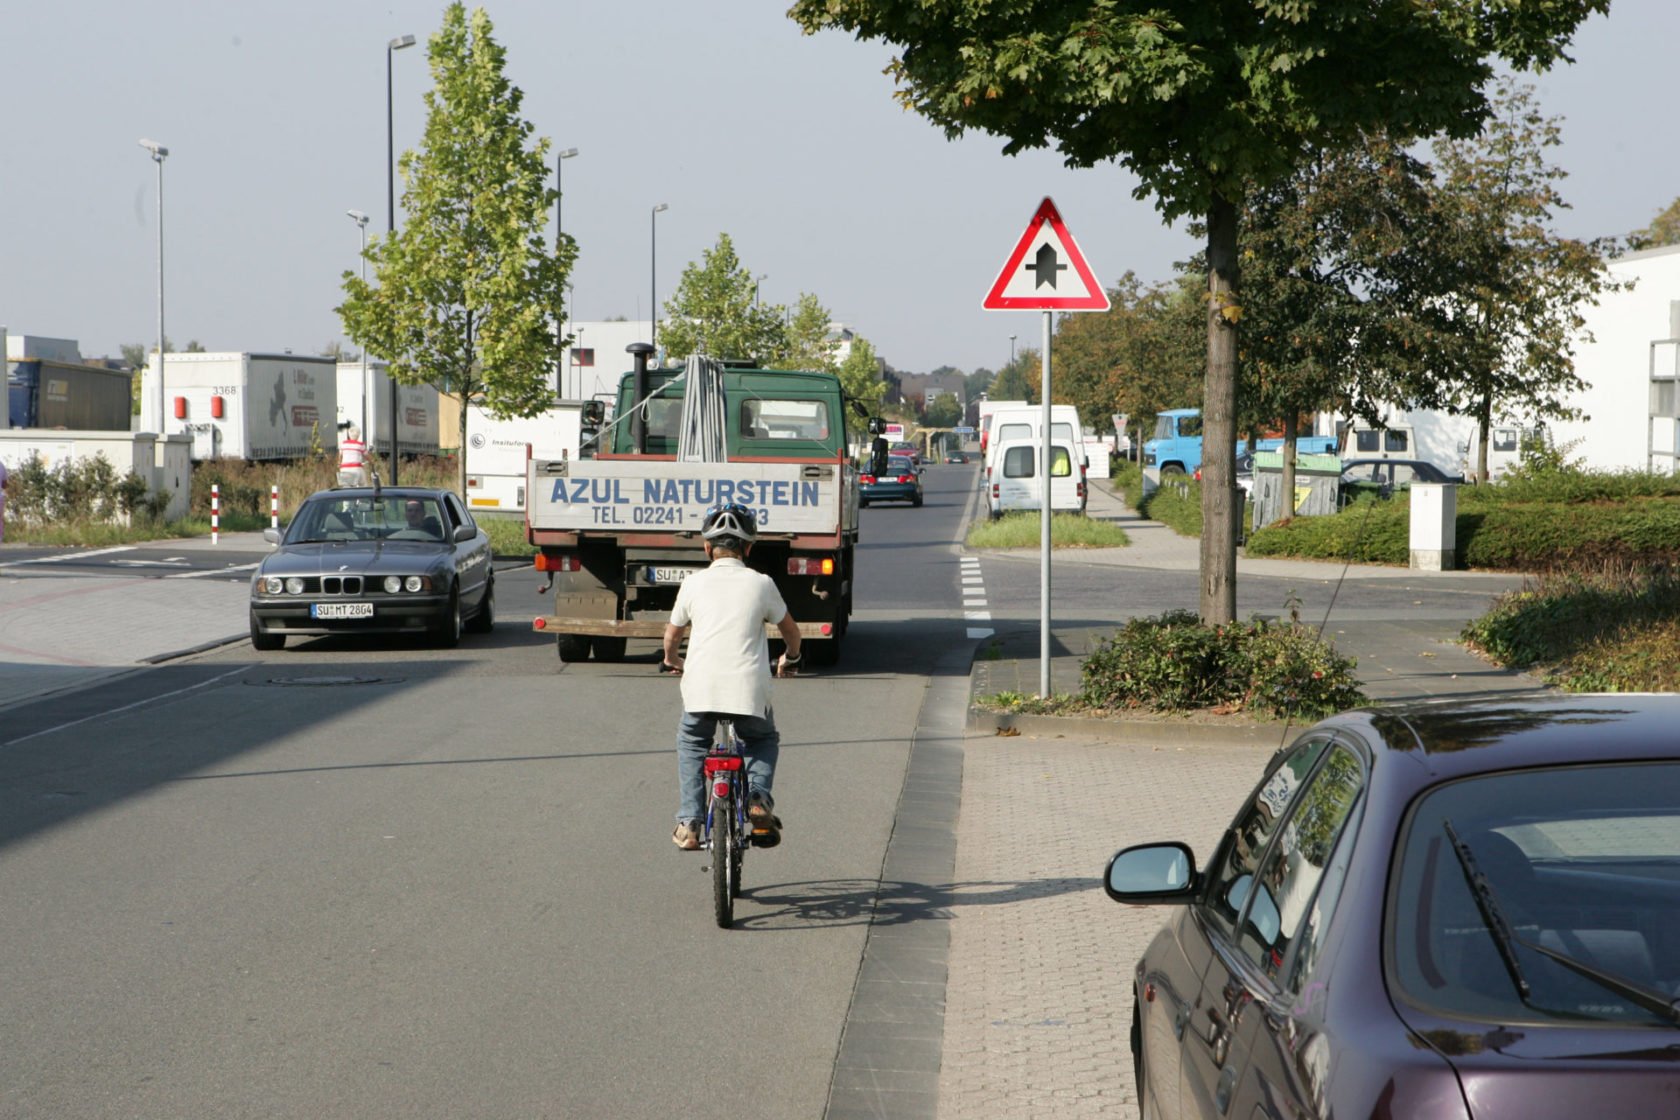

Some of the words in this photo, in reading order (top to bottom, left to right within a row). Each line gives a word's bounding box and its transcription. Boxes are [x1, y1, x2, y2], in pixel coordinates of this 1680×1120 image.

[212, 385, 237, 396] 3368
[550, 478, 630, 504] AZUL
[643, 478, 819, 507] NATURSTEIN
[592, 506, 626, 524] TEL.
[633, 506, 684, 525] 02241
[656, 569, 672, 581] SU
[317, 604, 330, 616] SU
